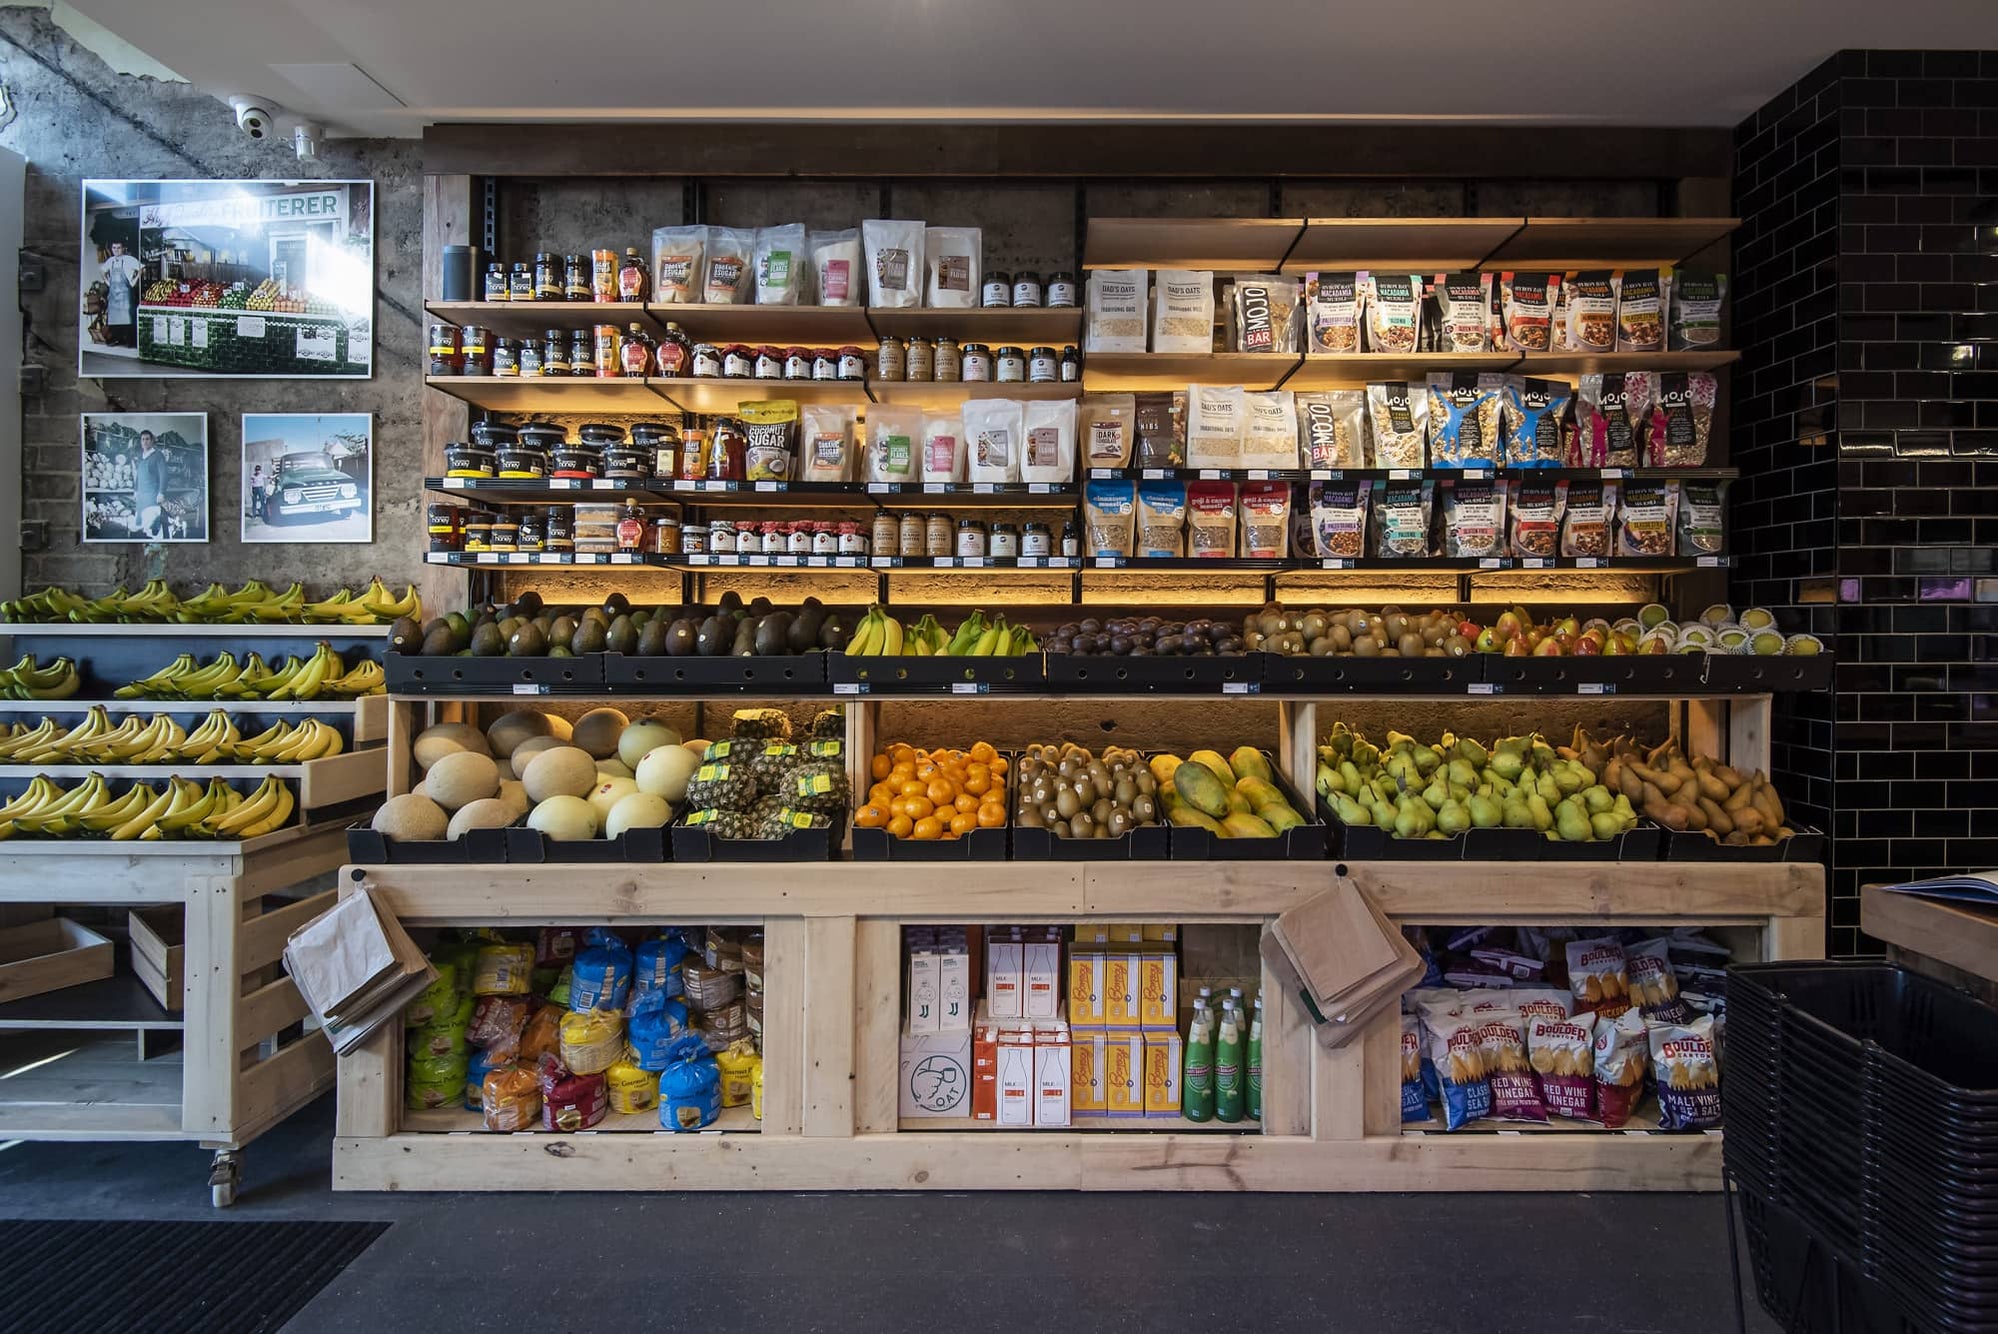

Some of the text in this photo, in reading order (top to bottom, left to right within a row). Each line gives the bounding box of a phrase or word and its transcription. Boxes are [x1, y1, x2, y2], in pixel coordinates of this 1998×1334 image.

[1120, 285, 1135, 293] OATS
[1185, 286, 1200, 294] OATS
[1321, 289, 1352, 297] MACADAMIA
[1380, 288, 1410, 297] MACADAMIA
[1245, 287, 1269, 332] MOJO
[1247, 331, 1271, 346] BAR
[1450, 386, 1481, 398] MOJO
[1521, 390, 1551, 402] MOJO
[1599, 391, 1629, 405] MOJO
[1660, 389, 1693, 403] MOJO
[1217, 404, 1233, 412] OATS
[1384, 396, 1412, 407] MOJO
[1309, 404, 1334, 444] MOJO
[749, 426, 786, 437] COCONUT
[1098, 431, 1116, 439] DARK
[748, 434, 785, 449] SUGAR
[1313, 446, 1335, 460] BAR
[431, 515, 449, 525] honey
[494, 534, 513, 544] honey
[522, 534, 540, 544] honey
[1580, 948, 1624, 967] BOULDER
[1629, 957, 1665, 973] ULDER
[1519, 1003, 1567, 1021] BOULDER
[1536, 1024, 1587, 1042] BOULDER
[1662, 1039, 1712, 1060] BOULDE
[1491, 1076, 1534, 1088] RED WINE
[935, 1086, 961, 1108] OAT
[1466, 1084, 1489, 1098] CLASS
[1543, 1084, 1588, 1098] RED WINE
[1467, 1099, 1482, 1110] SEA
[1547, 1095, 1587, 1108] VINEGAR
[1667, 1094, 1721, 1107] MALT VINE
[1701, 1105, 1721, 1117] SALT
